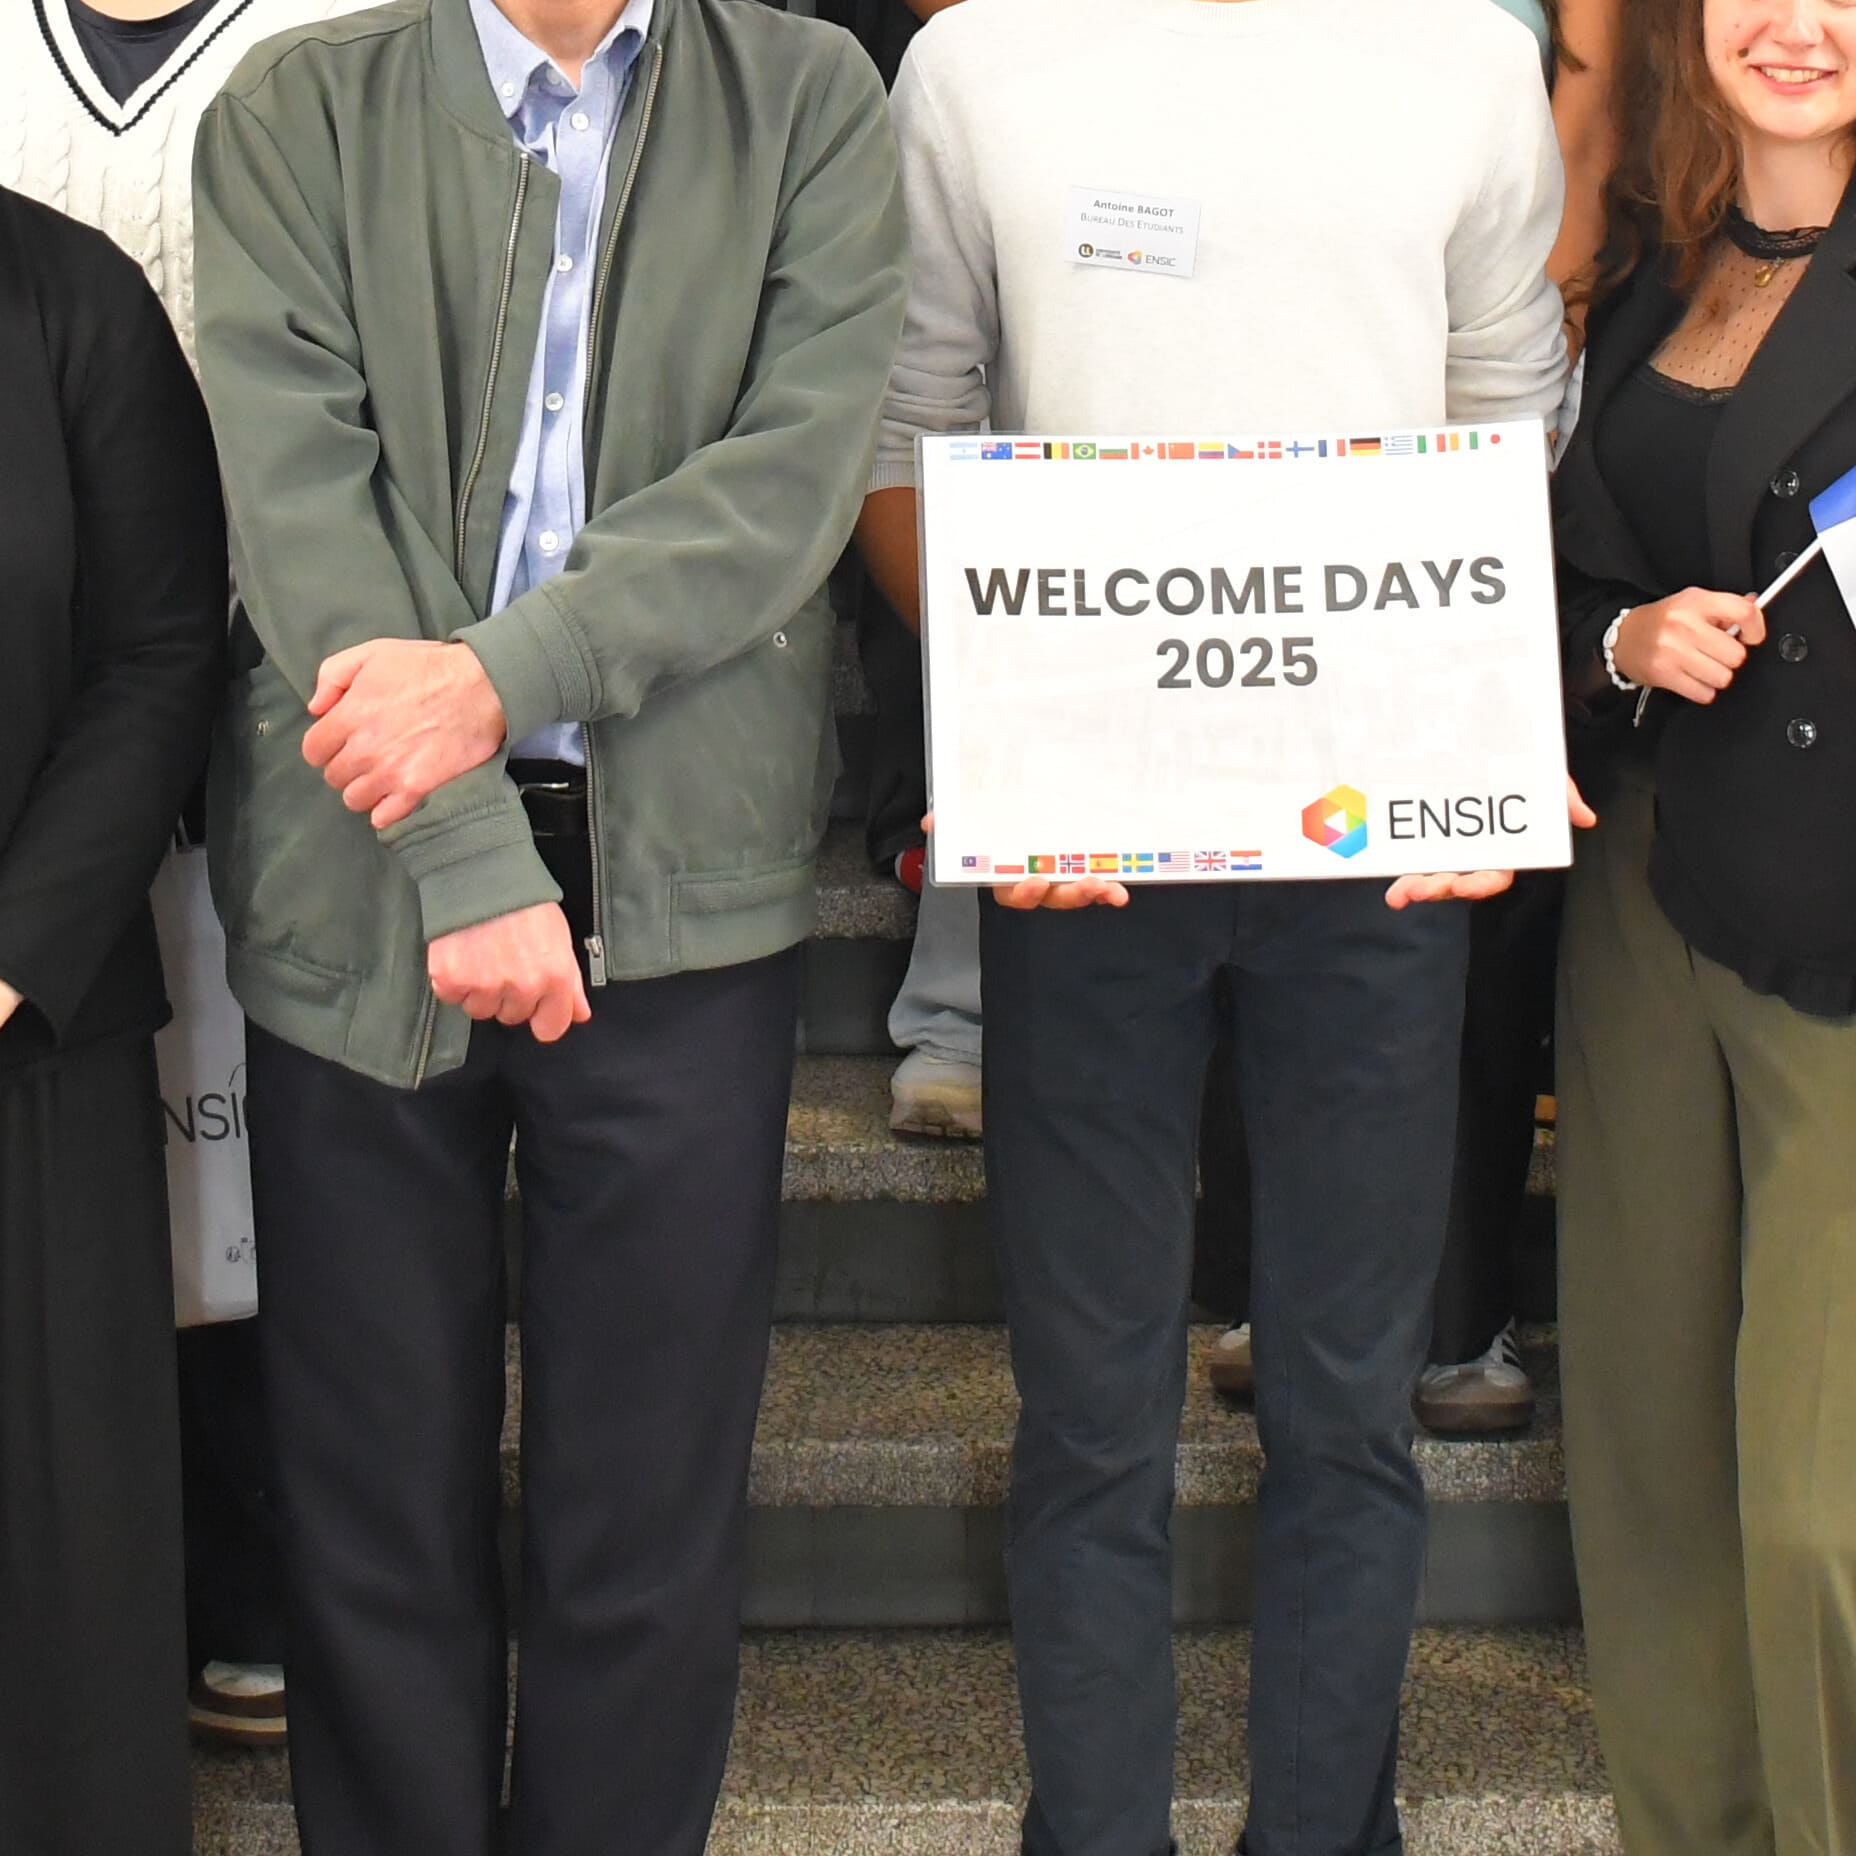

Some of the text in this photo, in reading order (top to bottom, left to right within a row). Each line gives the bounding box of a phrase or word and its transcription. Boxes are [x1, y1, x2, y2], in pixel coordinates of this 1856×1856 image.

[1093, 199, 1174, 218] Antoine BAGOT
[1145, 254, 1176, 267] ENSIC
[964, 555, 1507, 617] WELCOME DAYS
[1155, 636, 1319, 689] 2025
[1388, 793, 1529, 841] ENSIC
